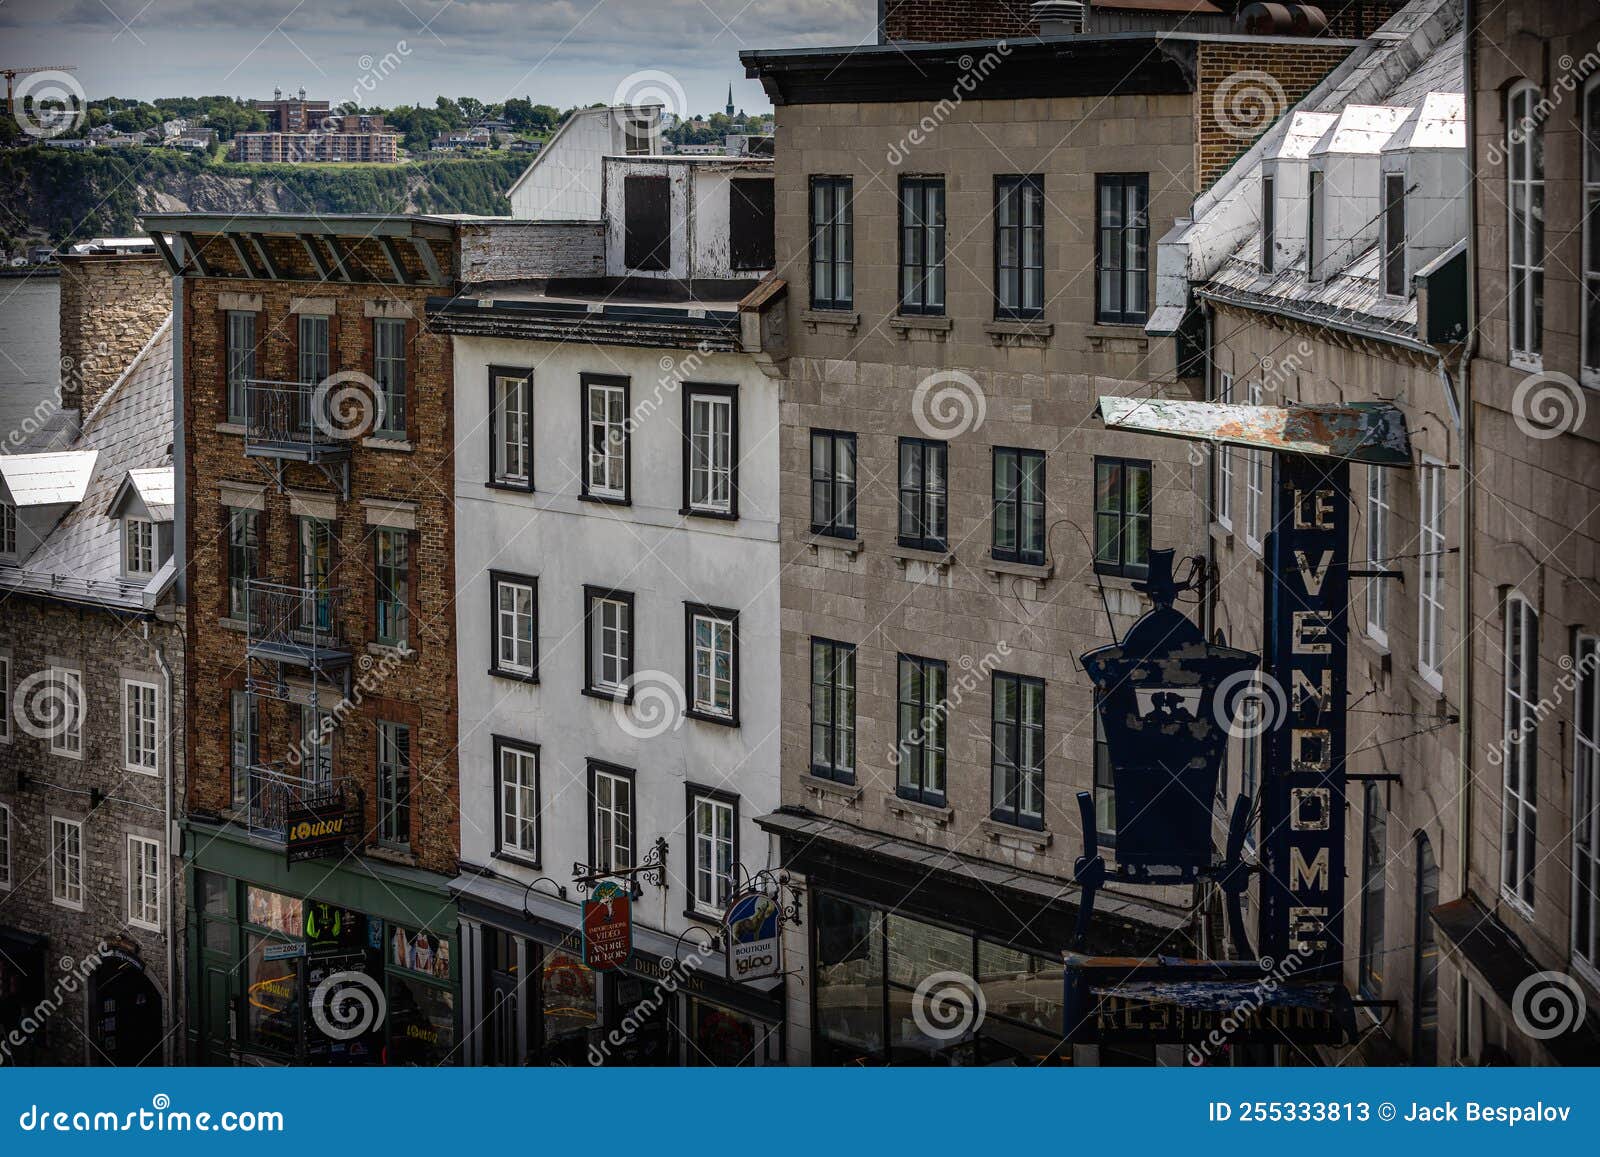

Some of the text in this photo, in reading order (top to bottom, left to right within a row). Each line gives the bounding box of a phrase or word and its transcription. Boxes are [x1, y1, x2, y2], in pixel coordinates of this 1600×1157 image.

[1293, 488, 1335, 531] LE
[1288, 549, 1335, 951] VENDOME
[290, 818, 343, 841] LOULOU
[736, 943, 771, 956] BOUTIQUE
[635, 958, 677, 980] DUBO
